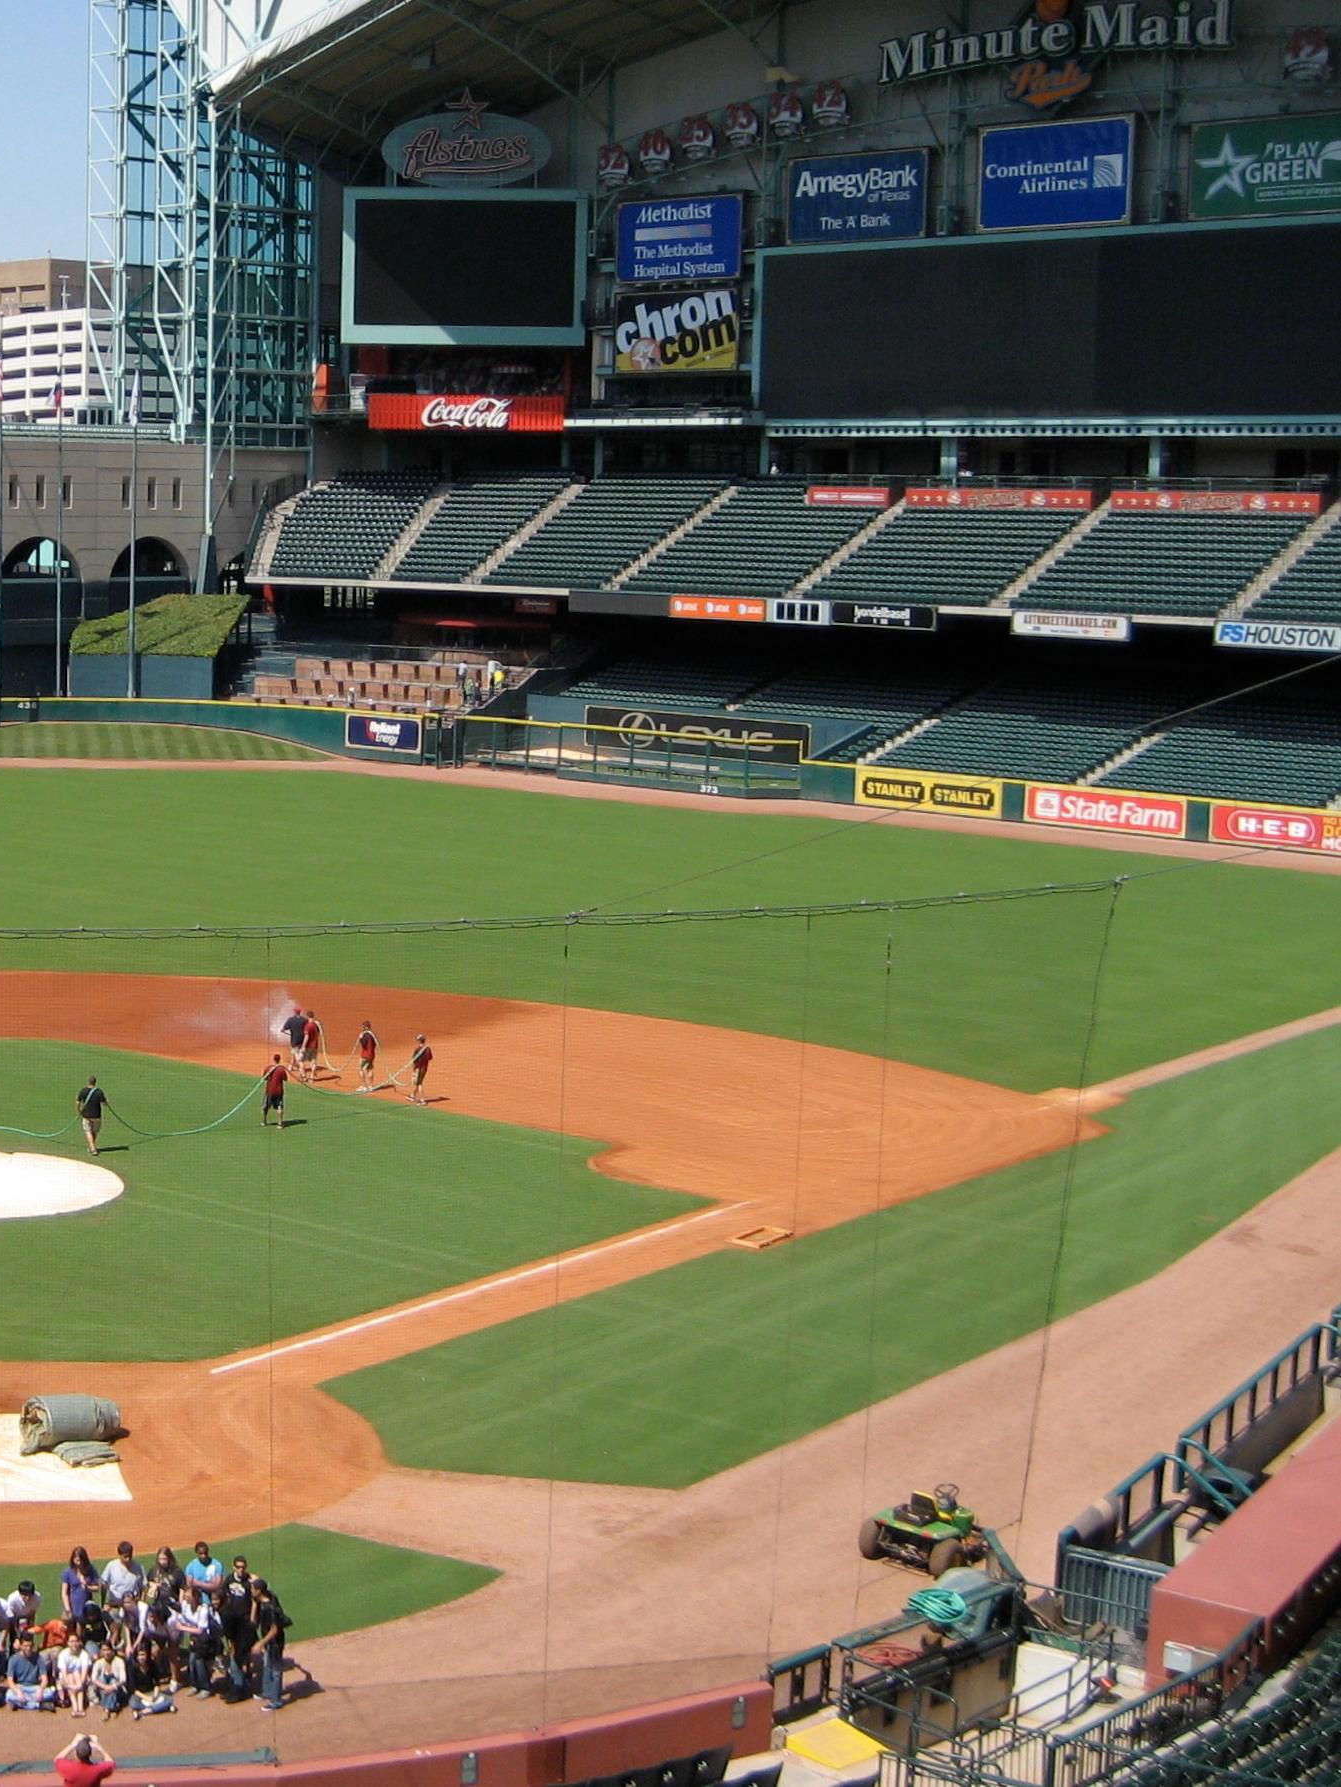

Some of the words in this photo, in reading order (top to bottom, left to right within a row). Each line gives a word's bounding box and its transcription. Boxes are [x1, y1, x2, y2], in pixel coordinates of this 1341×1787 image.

[879, 16, 1073, 84] Minute
[1084, 0, 1233, 48] Maid
[1008, 61, 1092, 102] Park
[402, 127, 532, 179] Astros
[1274, 141, 1320, 160] PLAY
[985, 157, 1088, 180] Continental
[1245, 159, 1323, 184] GREEN
[795, 164, 918, 198] AmegyBank
[1018, 177, 1088, 195] Airlines
[868, 191, 879, 203] of
[881, 190, 910, 202] Texas
[635, 204, 713, 224] Methodist
[820, 216, 843, 231] The
[860, 213, 891, 228] Bank
[634, 246, 656, 260] The
[658, 243, 714, 258] Methodist
[634, 262, 681, 279] Hospital
[682, 261, 726, 277] System
[616, 290, 734, 354] chron
[369, 721, 400, 735] Reliant
[660, 722, 774, 752] LEXUS
[699, 785, 719, 794] 373
[866, 781, 921, 799] STANLEY
[934, 788, 990, 806] STANLEY
[1238, 817, 1308, 838] H-E-B
